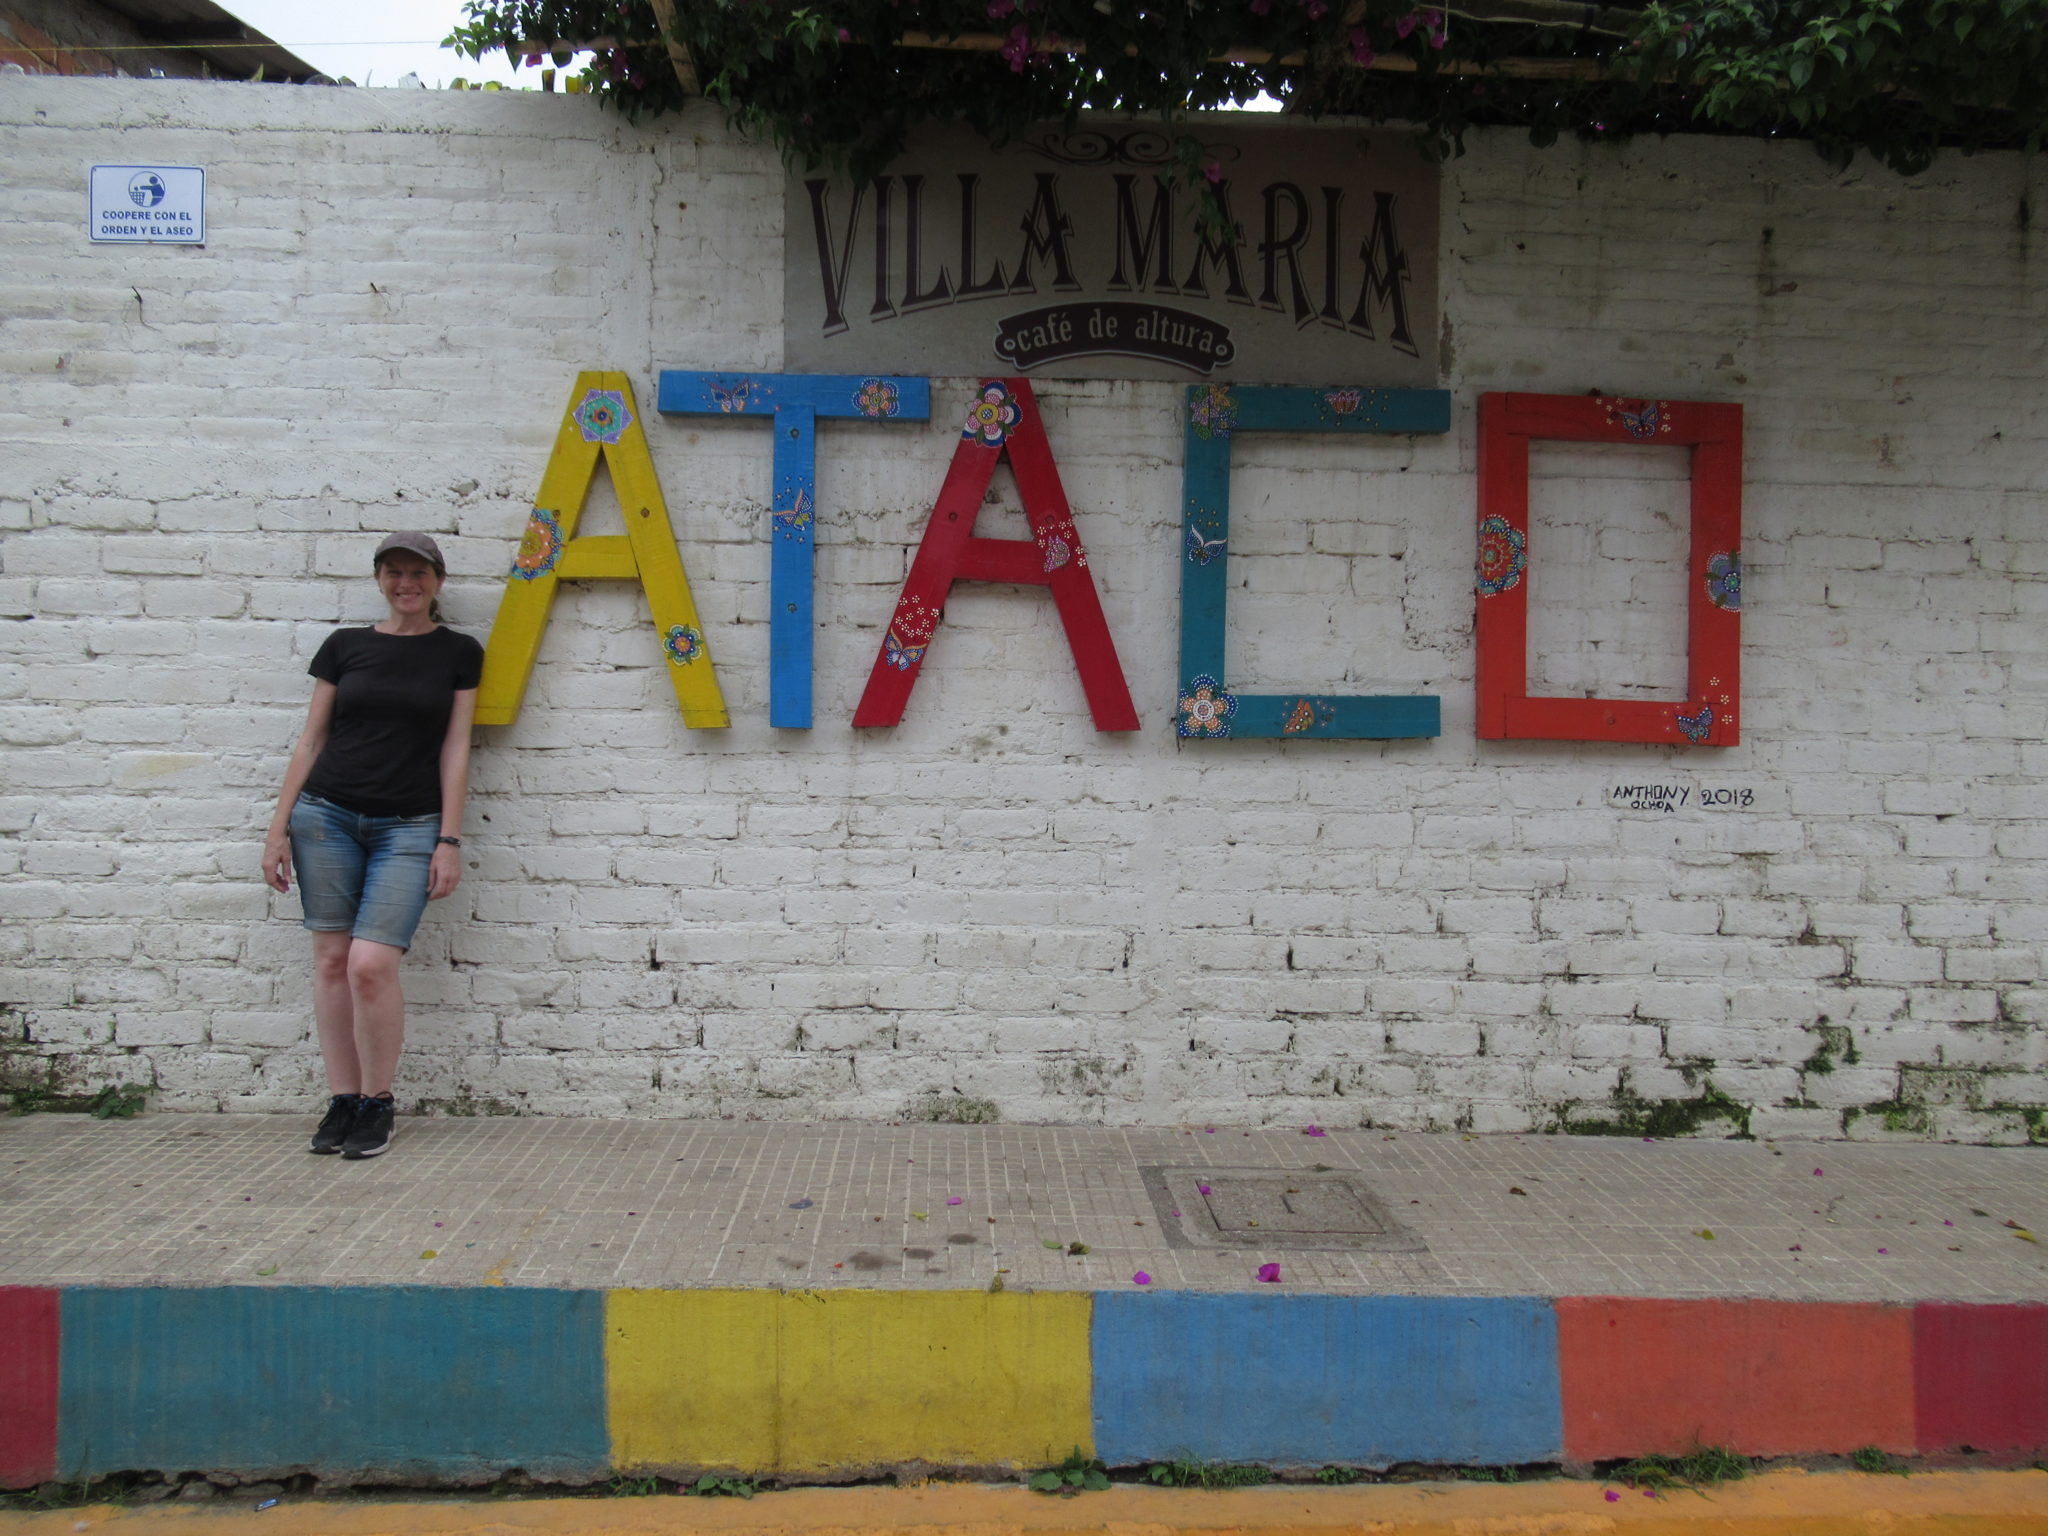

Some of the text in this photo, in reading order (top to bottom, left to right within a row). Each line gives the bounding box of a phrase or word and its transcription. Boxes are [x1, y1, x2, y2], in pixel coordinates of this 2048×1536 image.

[102, 211, 192, 221] COOPERE CON EL
[101, 225, 193, 236] ORDEN Y EL ASEO
[803, 173, 1420, 358] VILLA MARIA
[1016, 308, 1214, 353] café de altura
[473, 371, 1742, 747] ATACO
[1701, 788, 1755, 806] 2018
[1630, 800, 1675, 813] OCHOA
